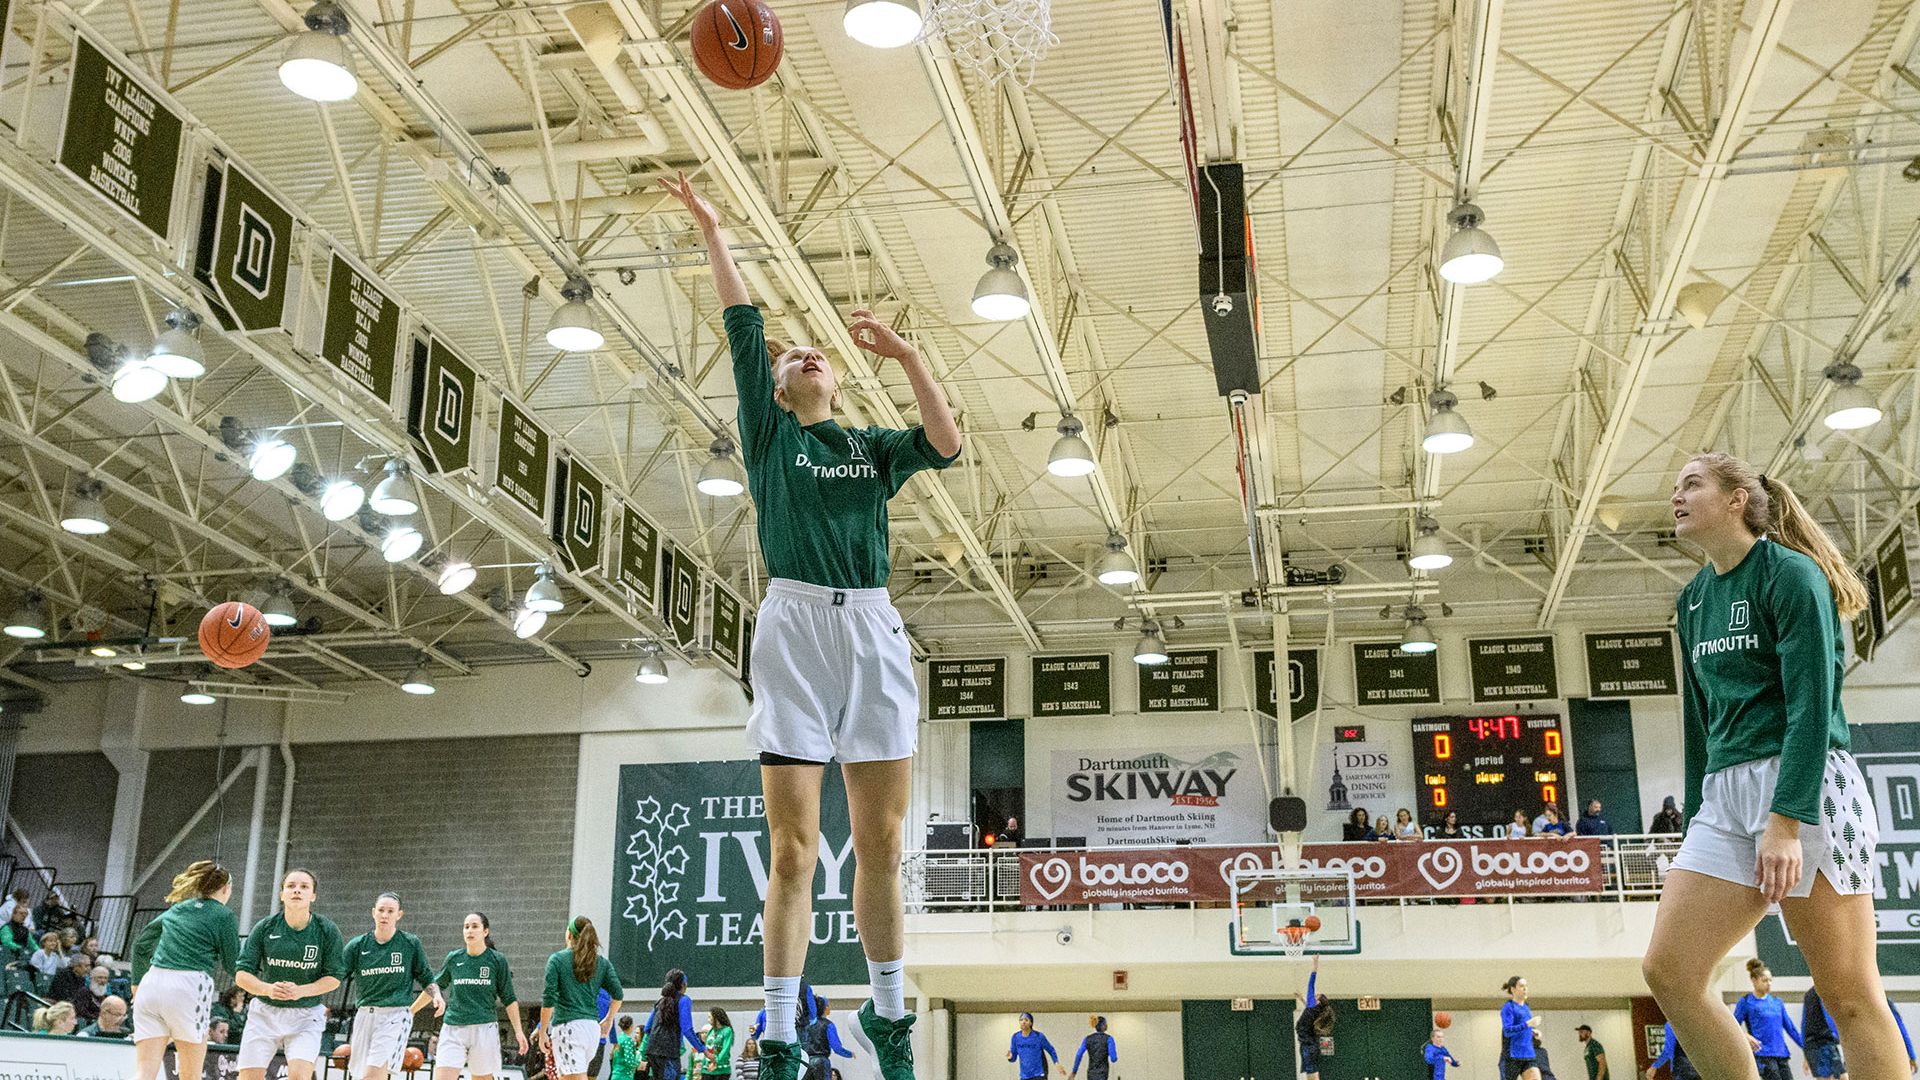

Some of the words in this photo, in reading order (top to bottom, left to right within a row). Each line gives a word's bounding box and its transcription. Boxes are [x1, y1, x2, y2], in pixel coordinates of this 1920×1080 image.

[106, 65, 122, 90] IVY
[124, 80, 156, 120] LEAGUE
[105, 88, 150, 136] CHAMPIONS
[102, 151, 138, 191] WOMEN'S
[90, 164, 140, 216] BASKETBALL
[1729, 600, 1749, 631] D
[1480, 645, 1504, 654] LEAGUE
[1508, 643, 1544, 653] CHAMPIONS
[1596, 639, 1622, 649] LEAGUE
[1625, 637, 1662, 648] CHAMPIONS
[1364, 650, 1389, 658] LEAGUE
[1042, 663, 1064, 671] LEAGUE
[1067, 661, 1100, 671] CHAMPIONS
[1175, 656, 1208, 665] CHAMPIONS
[938, 665, 960, 673] LEAGUE
[964, 664, 996, 672] CHAMPIONS
[1153, 671, 1169, 680] NCAA
[1172, 670, 1204, 679] FINALISTS
[942, 679, 958, 687] NCAA
[962, 677, 992, 686] FINALISTS
[1064, 682, 1079, 690] 1943
[1600, 681, 1620, 691] MEN'S
[1622, 679, 1667, 690] BASKETBALL
[1172, 685, 1186, 693] 1942
[1367, 690, 1386, 699] MEN'S
[1388, 688, 1429, 698] BASKETBALL
[1484, 687, 1502, 696] MEN'S
[1505, 685, 1547, 695] BASKETBALL
[960, 692, 974, 700] 1944
[1042, 702, 1060, 710] MEN'S
[1062, 700, 1101, 710] BASKETBALL
[1149, 699, 1167, 708] MEN'S
[1170, 698, 1209, 707] BASKETBALL
[938, 706, 956, 714] MEN'S
[958, 704, 996, 714] BASKETBALL
[1413, 723, 1450, 732] DARTMOUTH
[1469, 716, 1520, 740] 4:47
[1527, 720, 1556, 728] VISITORS
[1079, 755, 1169, 771] Dartmouth
[1345, 753, 1388, 767] DDS
[1475, 755, 1504, 766] period
[1066, 769, 1237, 802] SKIWAY
[1352, 782, 1386, 791] DINING
[1176, 797, 1193, 805] EST.
[1195, 796, 1215, 805] 1956
[700, 796, 766, 820] THE
[1097, 815, 1123, 824] Home
[1125, 814, 1134, 823] of
[1136, 813, 1185, 822] Dartmouth
[1187, 813, 1215, 822] Skiing
[1424, 825, 1484, 839] CSS
[1476, 879, 1514, 890] globally
[1515, 878, 1552, 888] inspired
[1554, 877, 1590, 885] burritos
[1082, 887, 1118, 899] globally
[1119, 886, 1154, 898] inspired
[1156, 885, 1188, 895] burritos
[696, 911, 860, 946] LEAUE
[267, 957, 318, 969] ARTMOUTH
[361, 966, 405, 976] DARTMOUTH
[1232, 1000, 1252, 1010] EXIT
[1359, 999, 1379, 1009] EXIT
